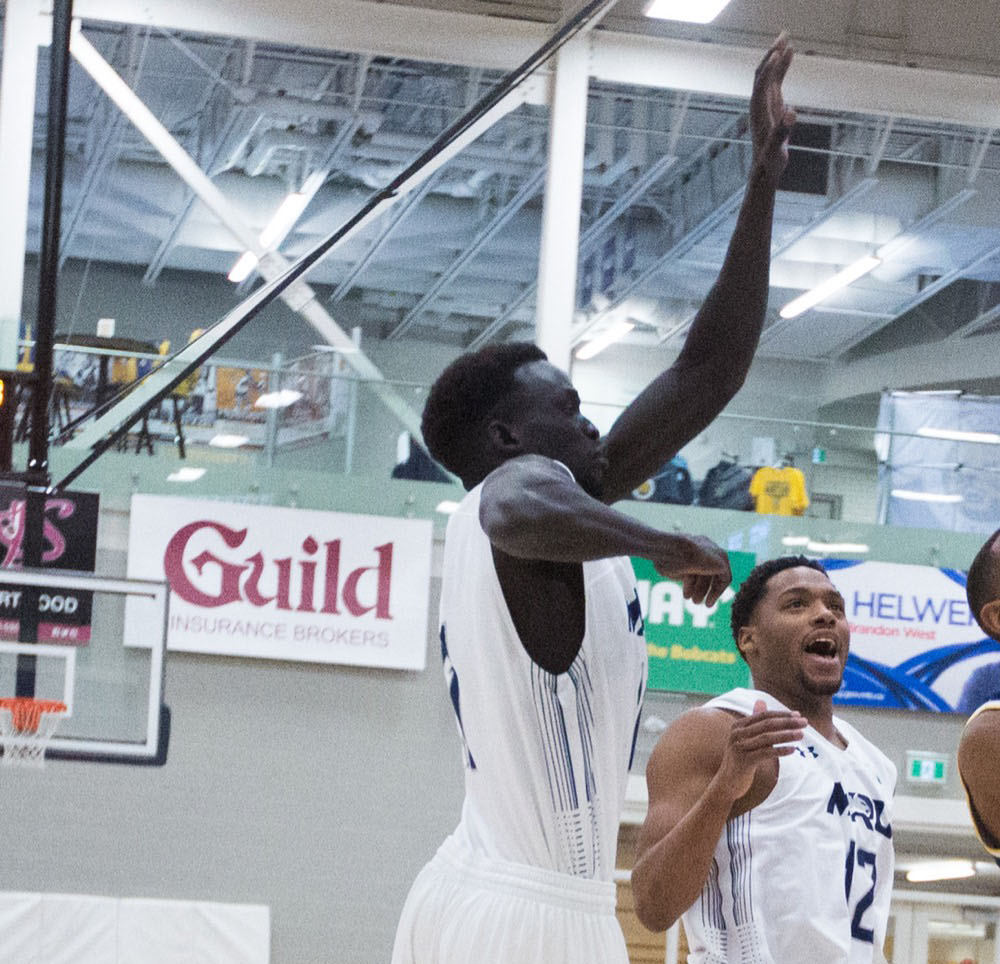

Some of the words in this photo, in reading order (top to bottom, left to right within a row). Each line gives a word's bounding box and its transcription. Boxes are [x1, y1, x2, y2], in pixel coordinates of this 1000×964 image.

[164, 520, 394, 621] Guild
[171, 615, 288, 640] INSURANCE
[292, 624, 390, 648] BROKERS
[852, 590, 974, 628] HELWE
[845, 840, 877, 944] 12
